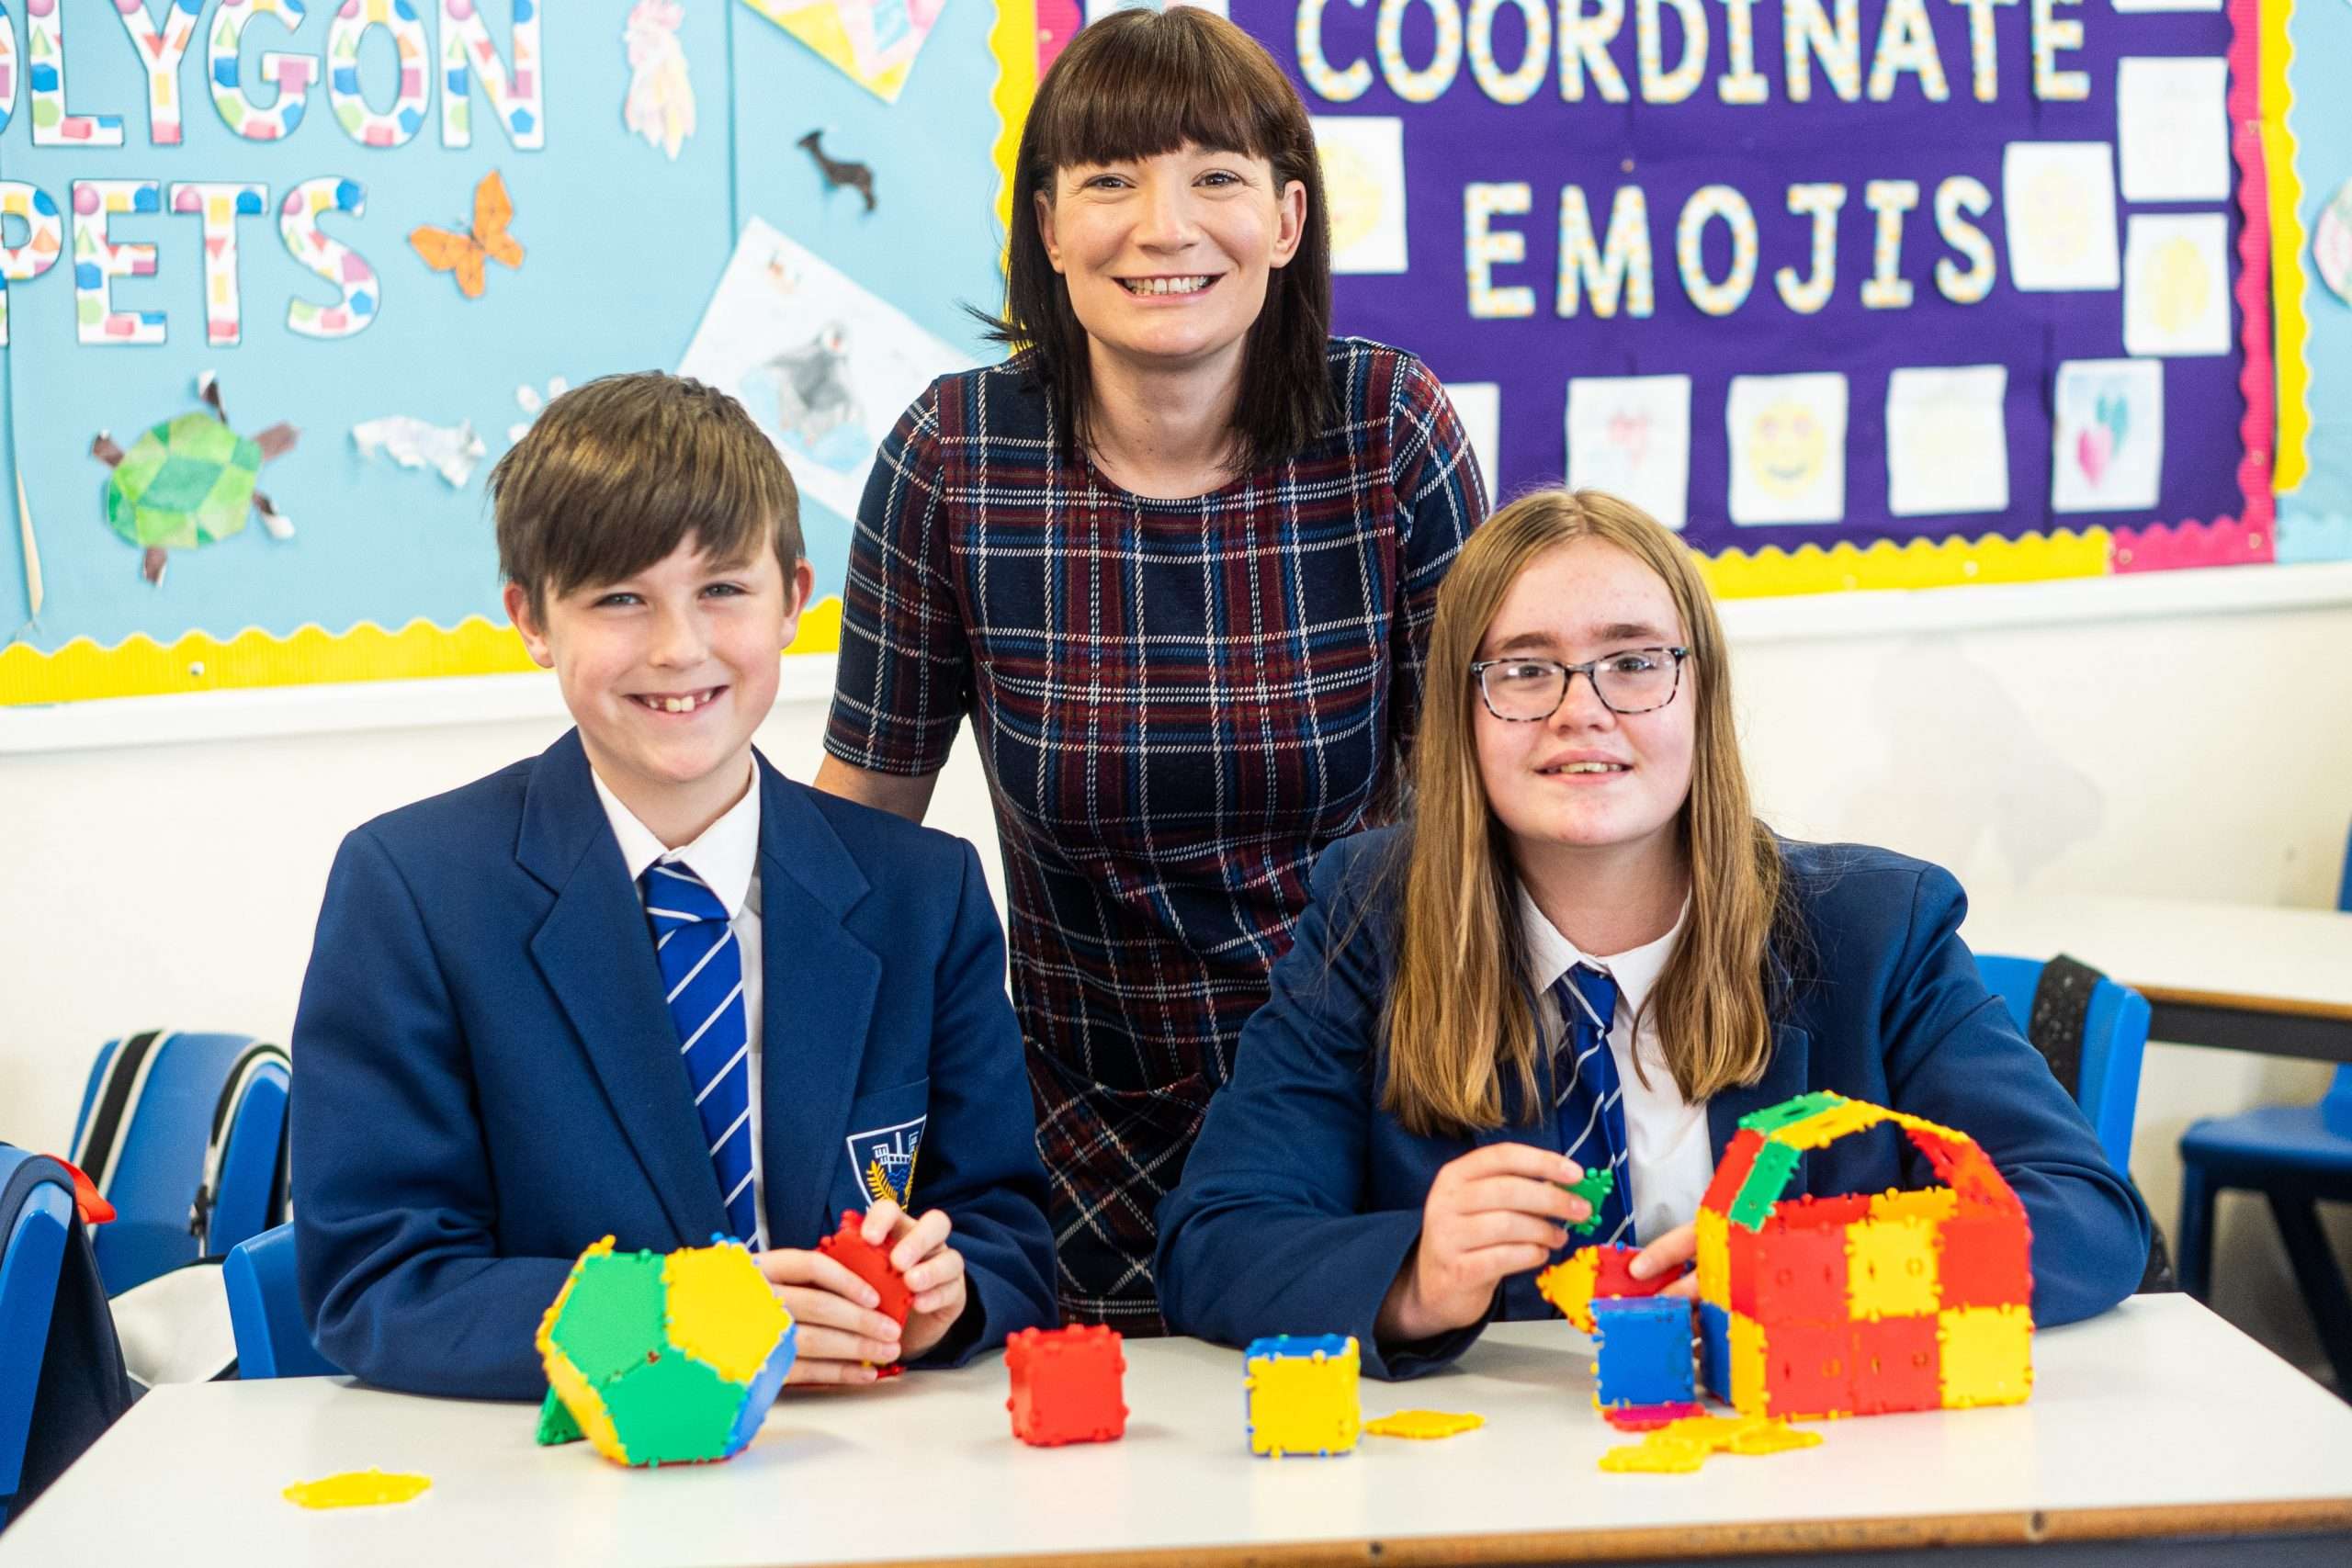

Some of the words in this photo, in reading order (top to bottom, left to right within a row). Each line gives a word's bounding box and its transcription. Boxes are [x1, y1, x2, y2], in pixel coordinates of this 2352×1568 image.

[0, 0, 546, 151] LYGON
[1295, 0, 2091, 105] COORDINATE
[1464, 175, 1997, 319] EMOJIS
